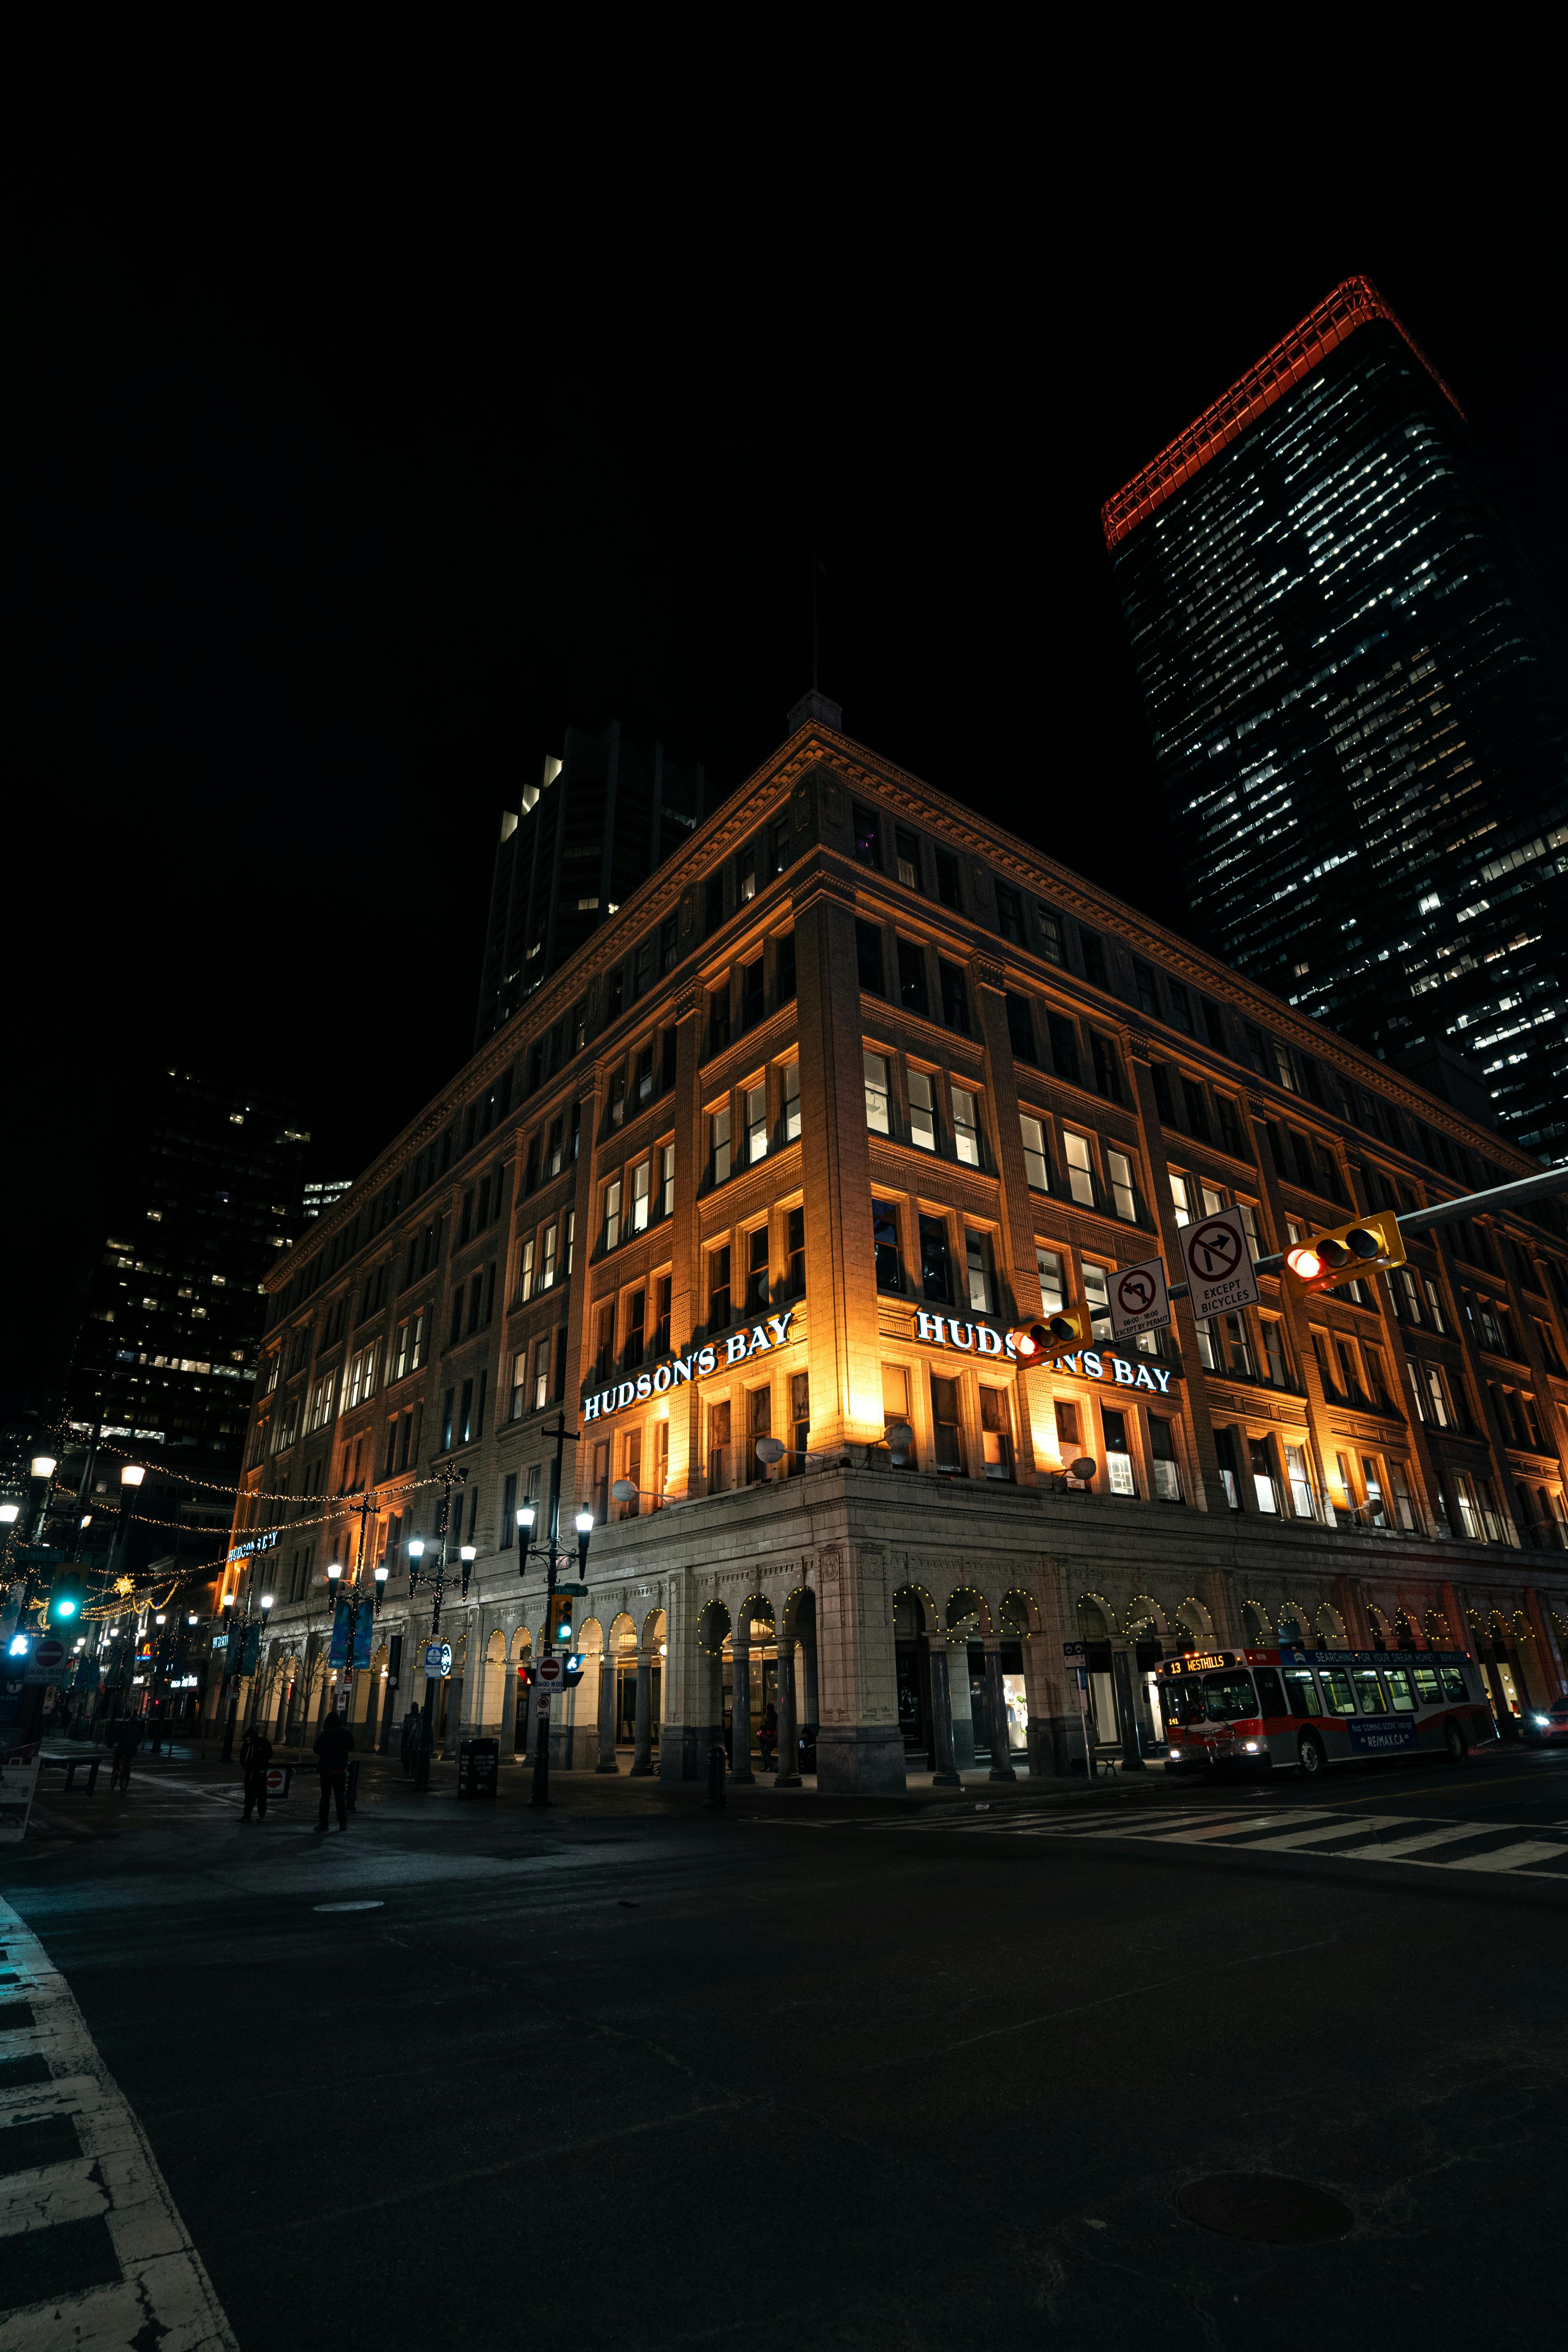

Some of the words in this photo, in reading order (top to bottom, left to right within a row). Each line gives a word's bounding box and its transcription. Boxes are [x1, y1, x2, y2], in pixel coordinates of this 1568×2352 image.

[1204, 1279, 1240, 1299] EXCEPT
[1201, 1290, 1249, 1312] BICYCLES
[1116, 1325, 1137, 1337] EXCEPT
[1147, 1315, 1168, 1327] PERMIT
[1123, 1316, 1139, 1326] 06:00
[1143, 1310, 1158, 1319] 18:00
[917, 1311, 1103, 1378] HUDSN'S
[1112, 1358, 1170, 1392] BAY
[584, 1347, 715, 1421] HUDSON'S
[726, 1312, 792, 1365] BAY
[228, 1538, 261, 1563] HUDSONS
[1171, 1662, 1181, 1674] 13
[1187, 1655, 1224, 1671] WESTHILLS
[1315, 1652, 1355, 1662] SEARCHING
[1357, 1653, 1372, 1662] FOR
[1373, 1653, 1391, 1662] YOUR
[1392, 1653, 1414, 1662] DREAM
[1367, 1734, 1405, 1747] RE/MAX.CA
